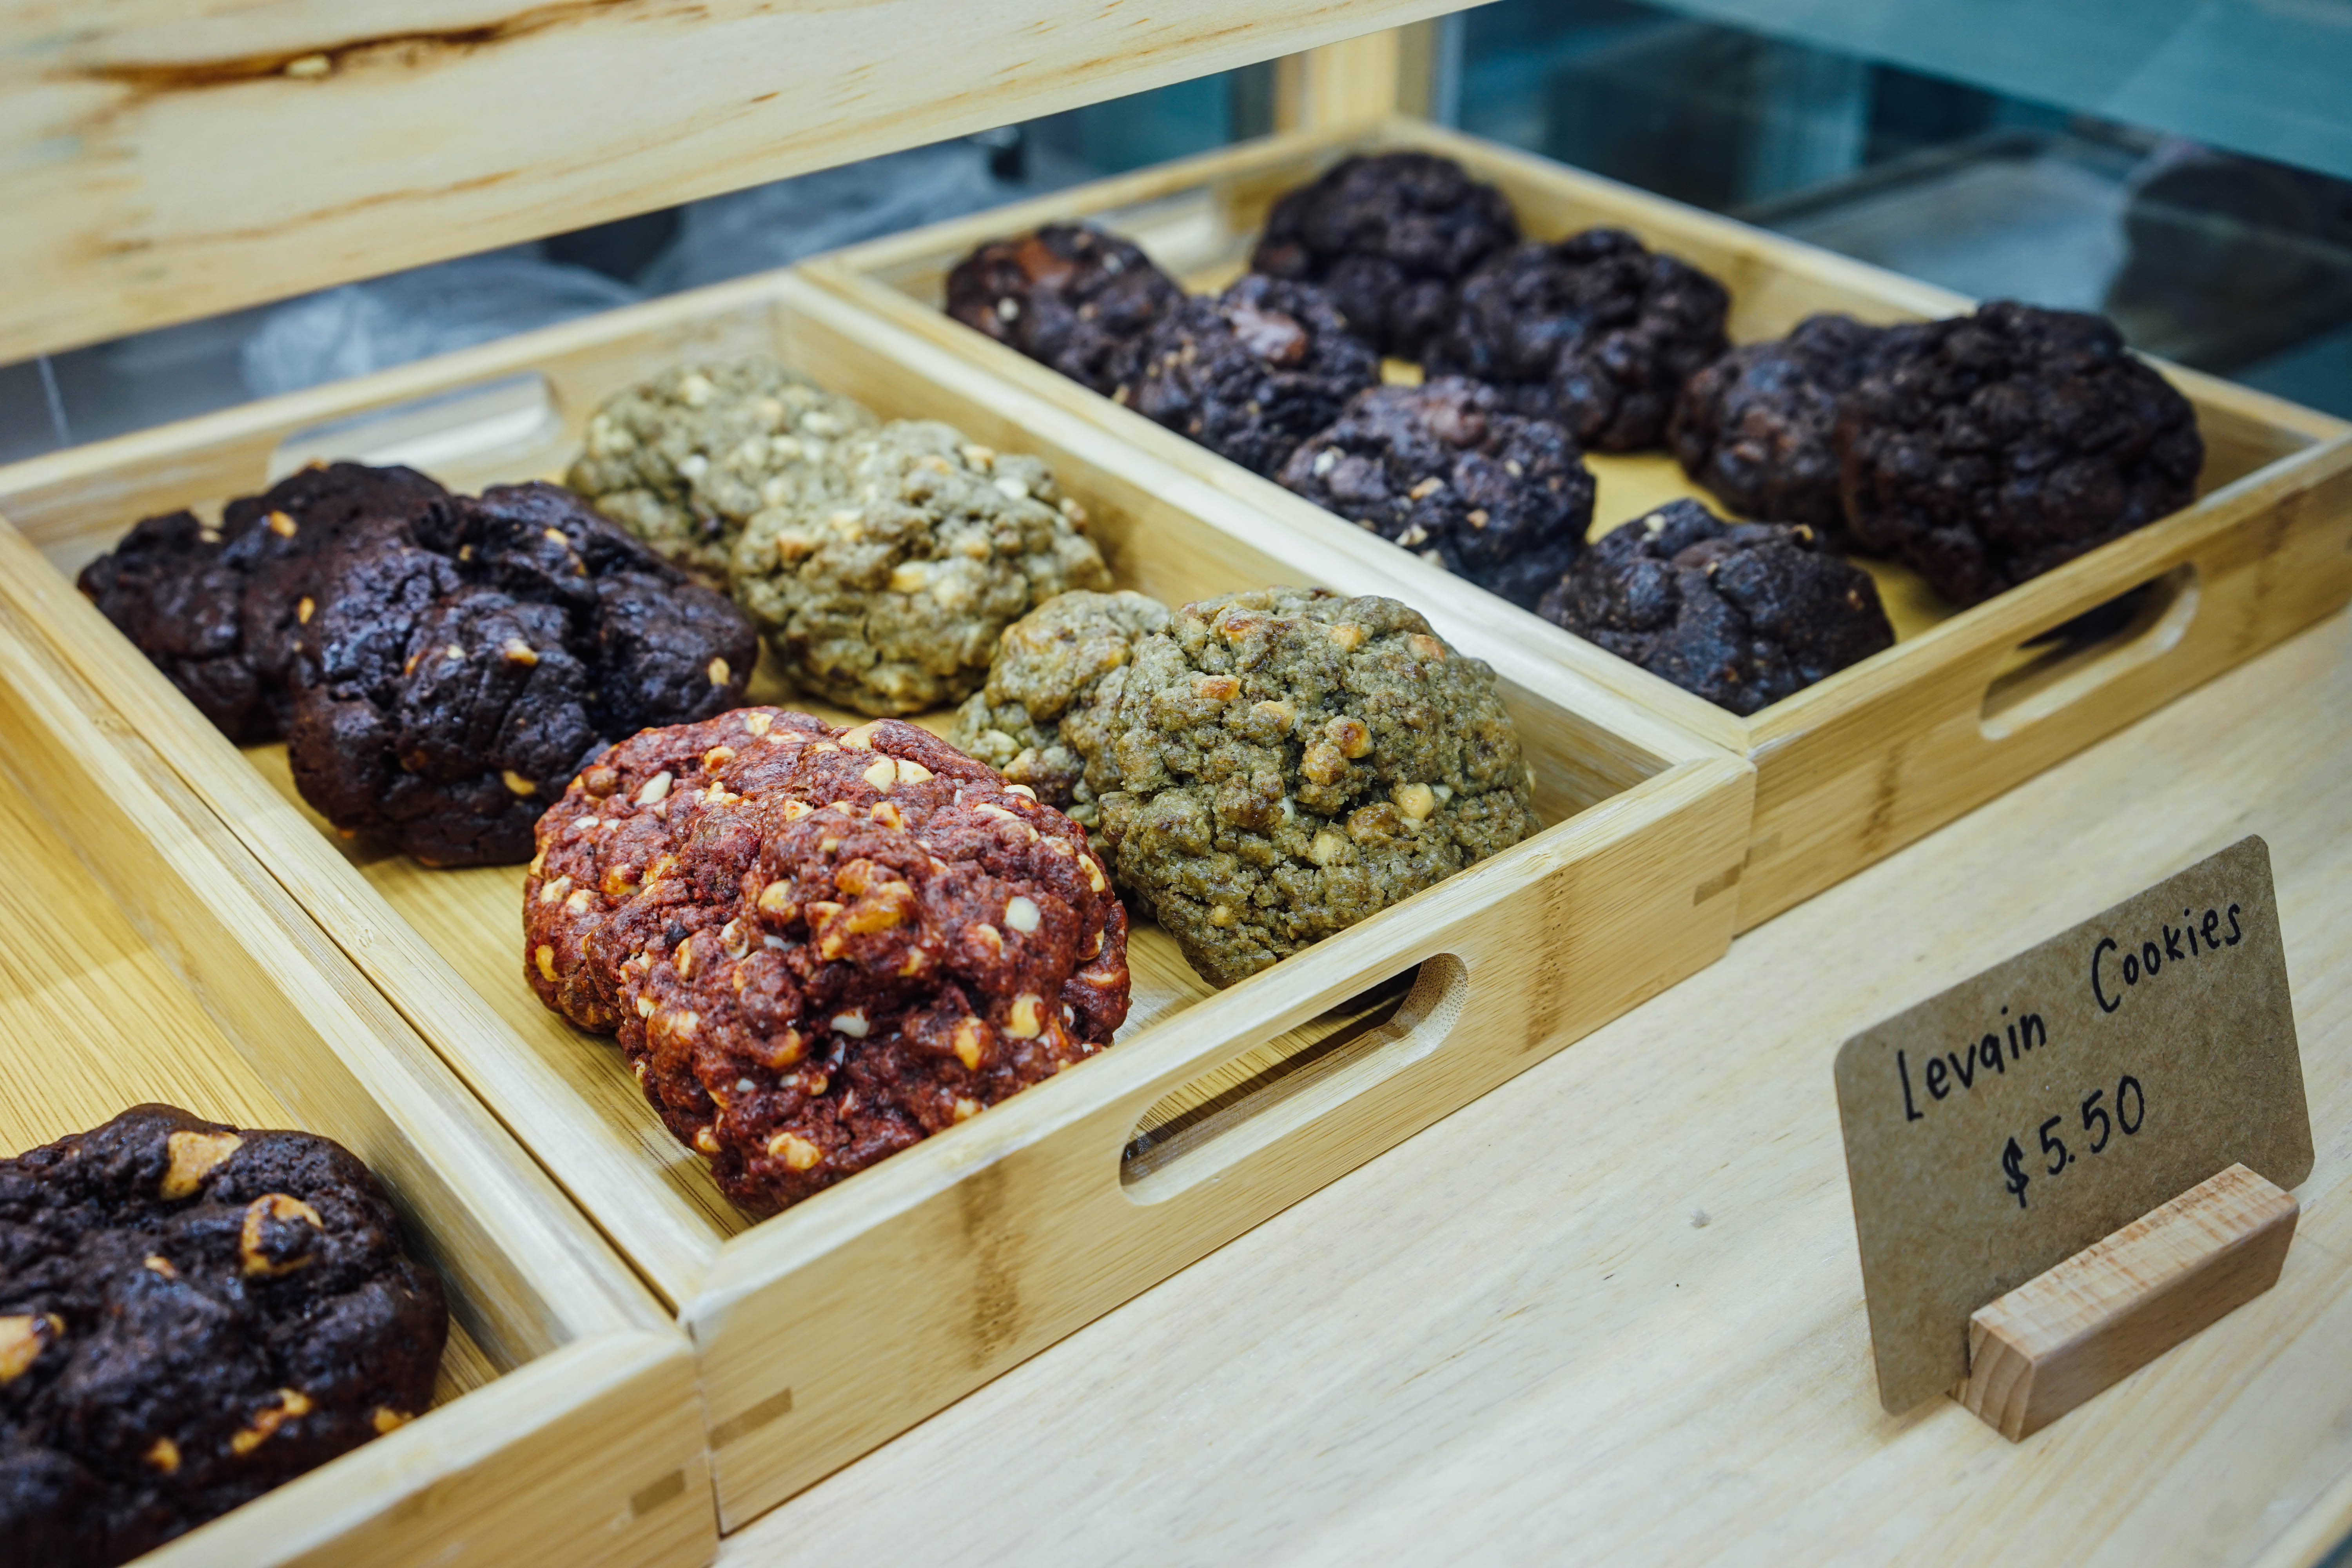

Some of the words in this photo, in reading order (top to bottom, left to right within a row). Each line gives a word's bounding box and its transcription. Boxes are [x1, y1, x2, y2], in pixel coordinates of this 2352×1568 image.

[1897, 1005, 2047, 1122] Levain
[2091, 903, 2242, 1014] Cookies
[2002, 1074, 2145, 1209] $5.50
